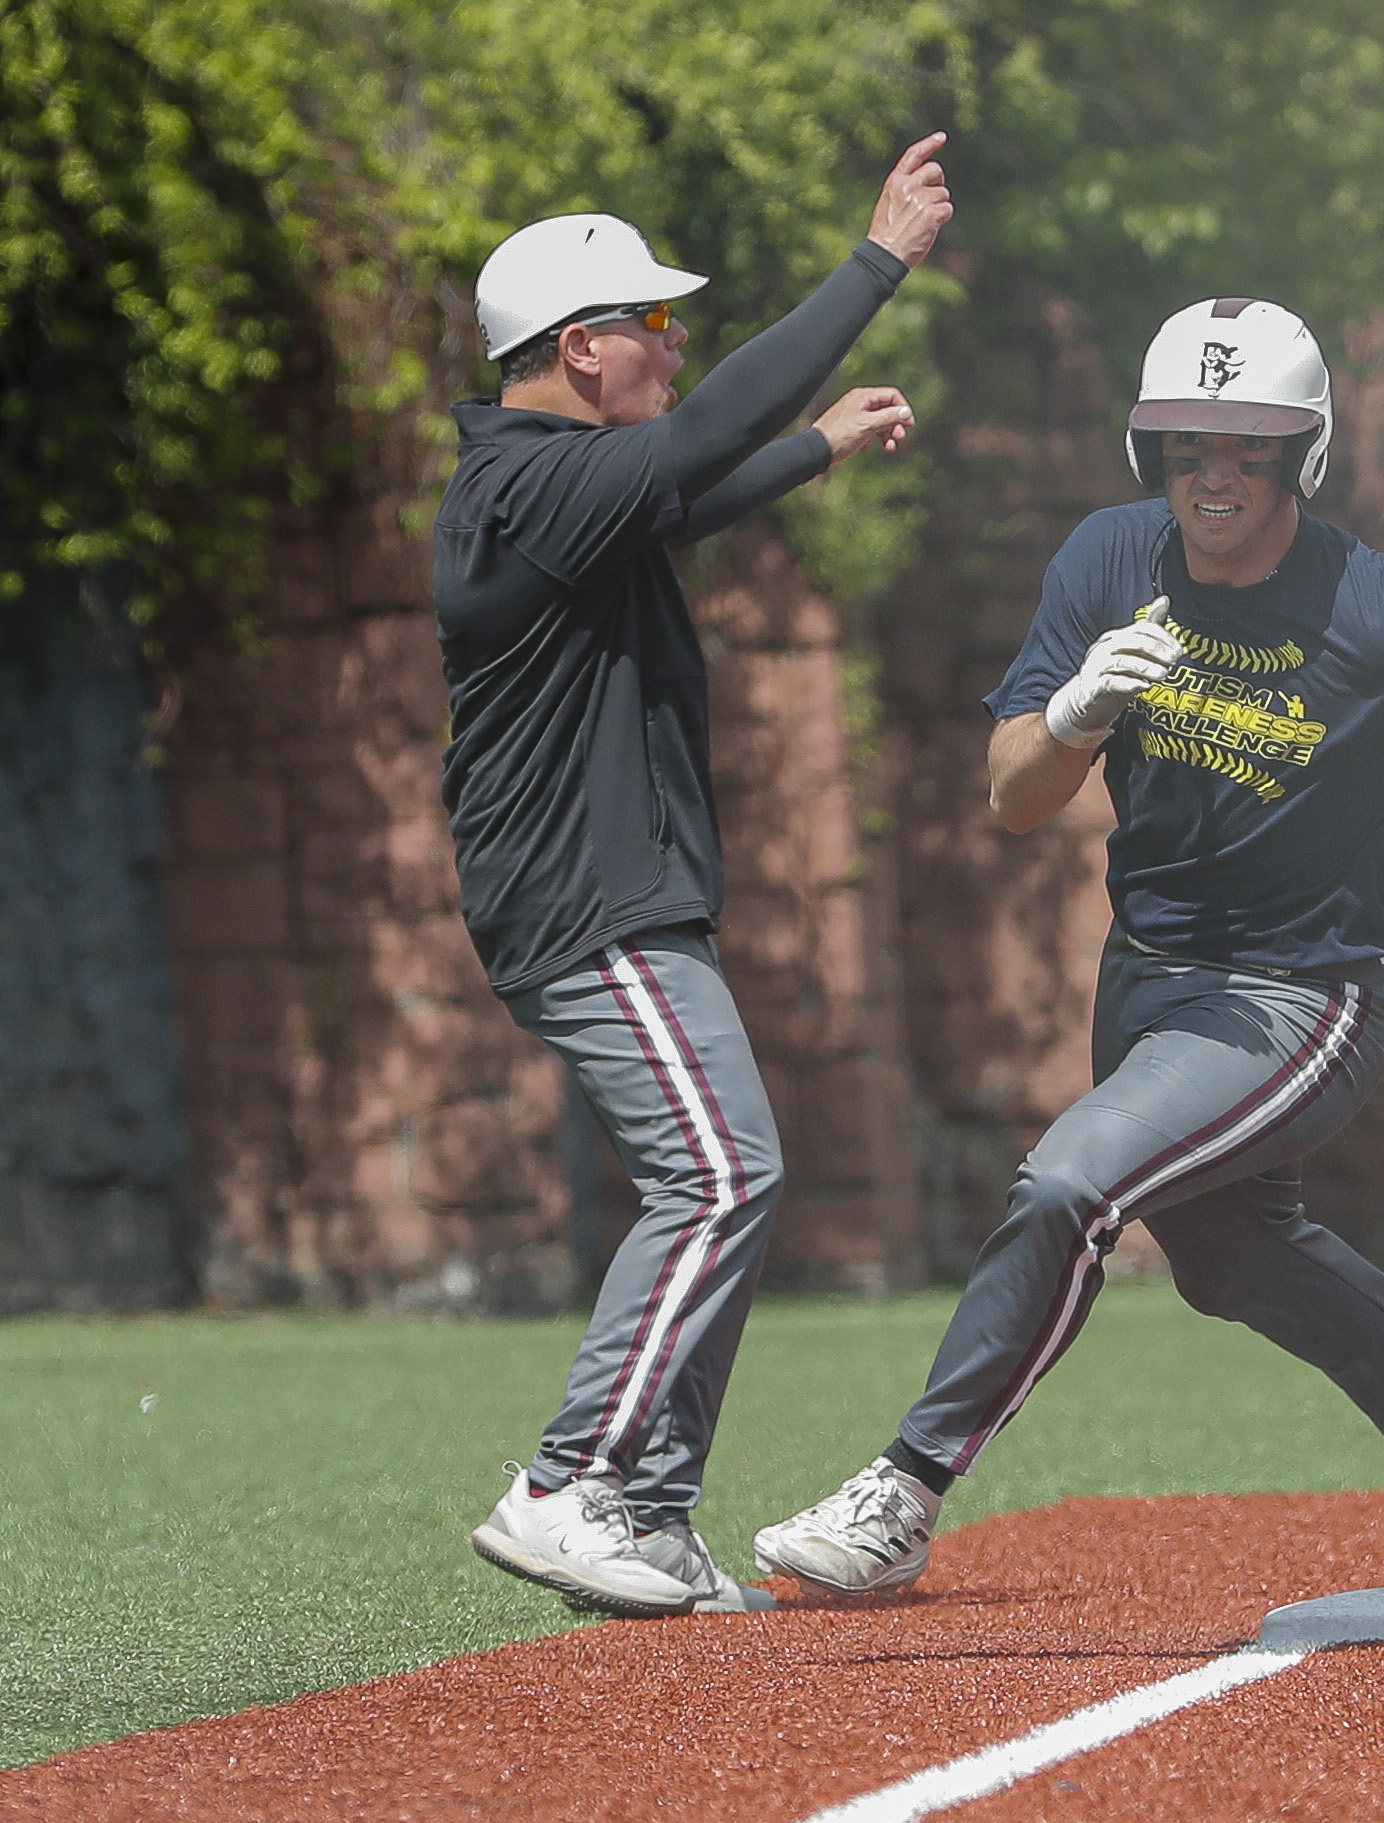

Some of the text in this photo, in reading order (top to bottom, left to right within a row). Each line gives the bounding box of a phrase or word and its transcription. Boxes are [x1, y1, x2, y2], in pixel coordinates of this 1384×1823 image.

[1134, 682, 1327, 744] ARENESS
[1161, 666, 1273, 710] UTISM
[1127, 699, 1315, 766] HALLENGE
